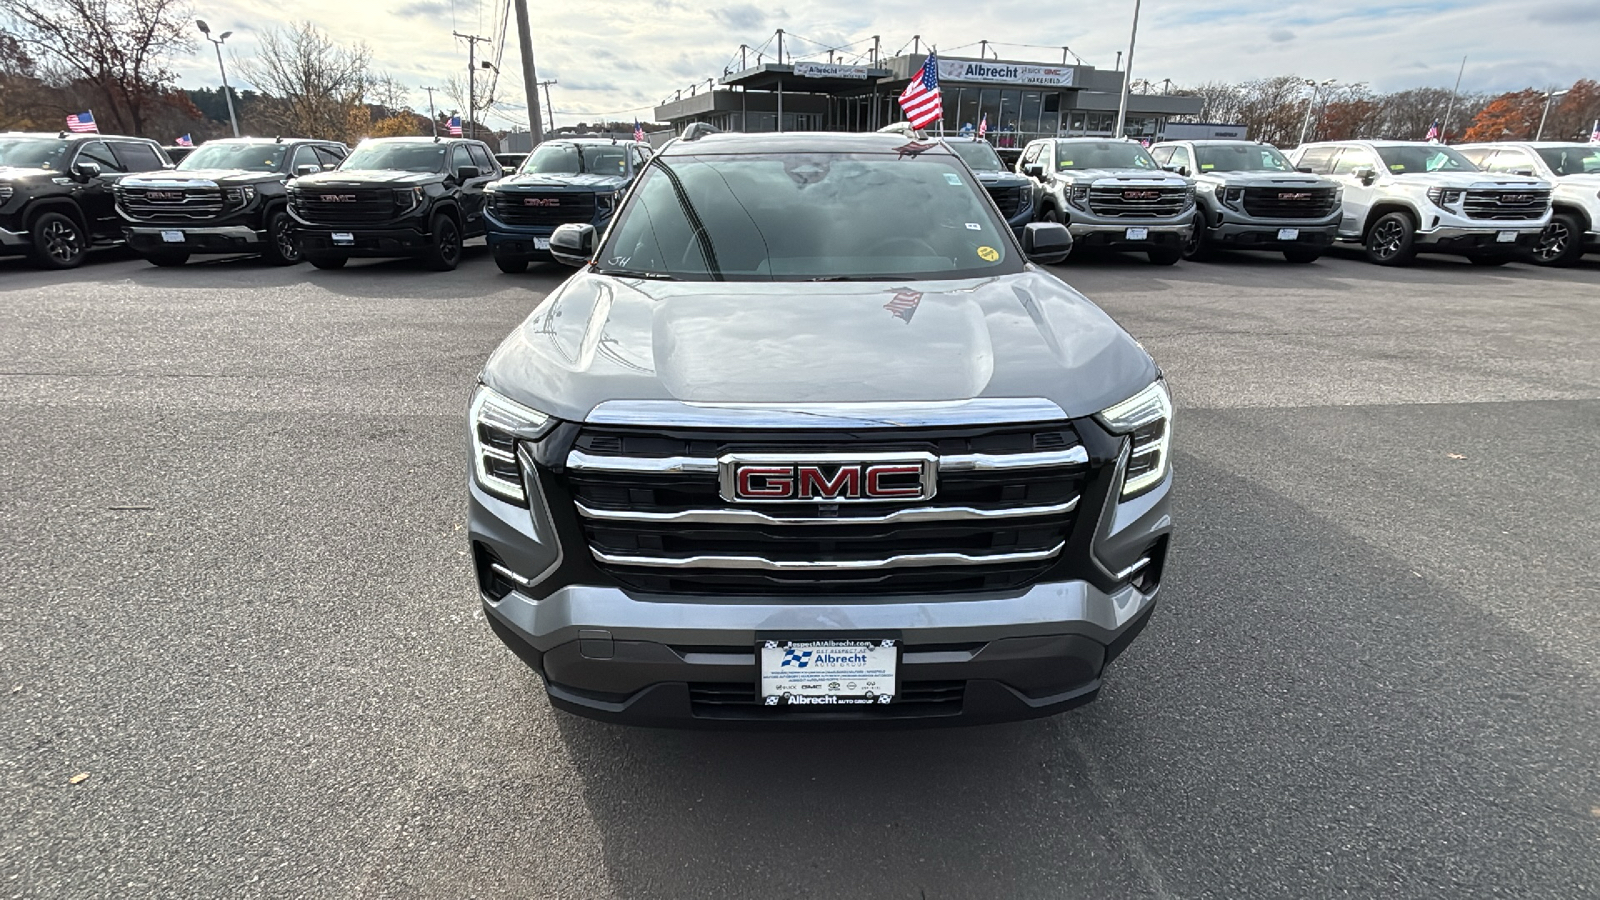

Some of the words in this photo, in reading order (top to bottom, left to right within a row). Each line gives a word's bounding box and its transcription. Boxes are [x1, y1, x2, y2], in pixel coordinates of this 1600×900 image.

[808, 66, 838, 75] Albrecht
[965, 64, 1018, 78] Albrecht
[320, 194, 357, 202] GMC
[1123, 191, 1159, 199] GMC
[1277, 192, 1312, 201] GMC
[523, 198, 561, 207] GMC
[737, 464, 922, 498] GMC
[815, 654, 867, 663] Albrecht
[788, 695, 837, 704] Albrecht
